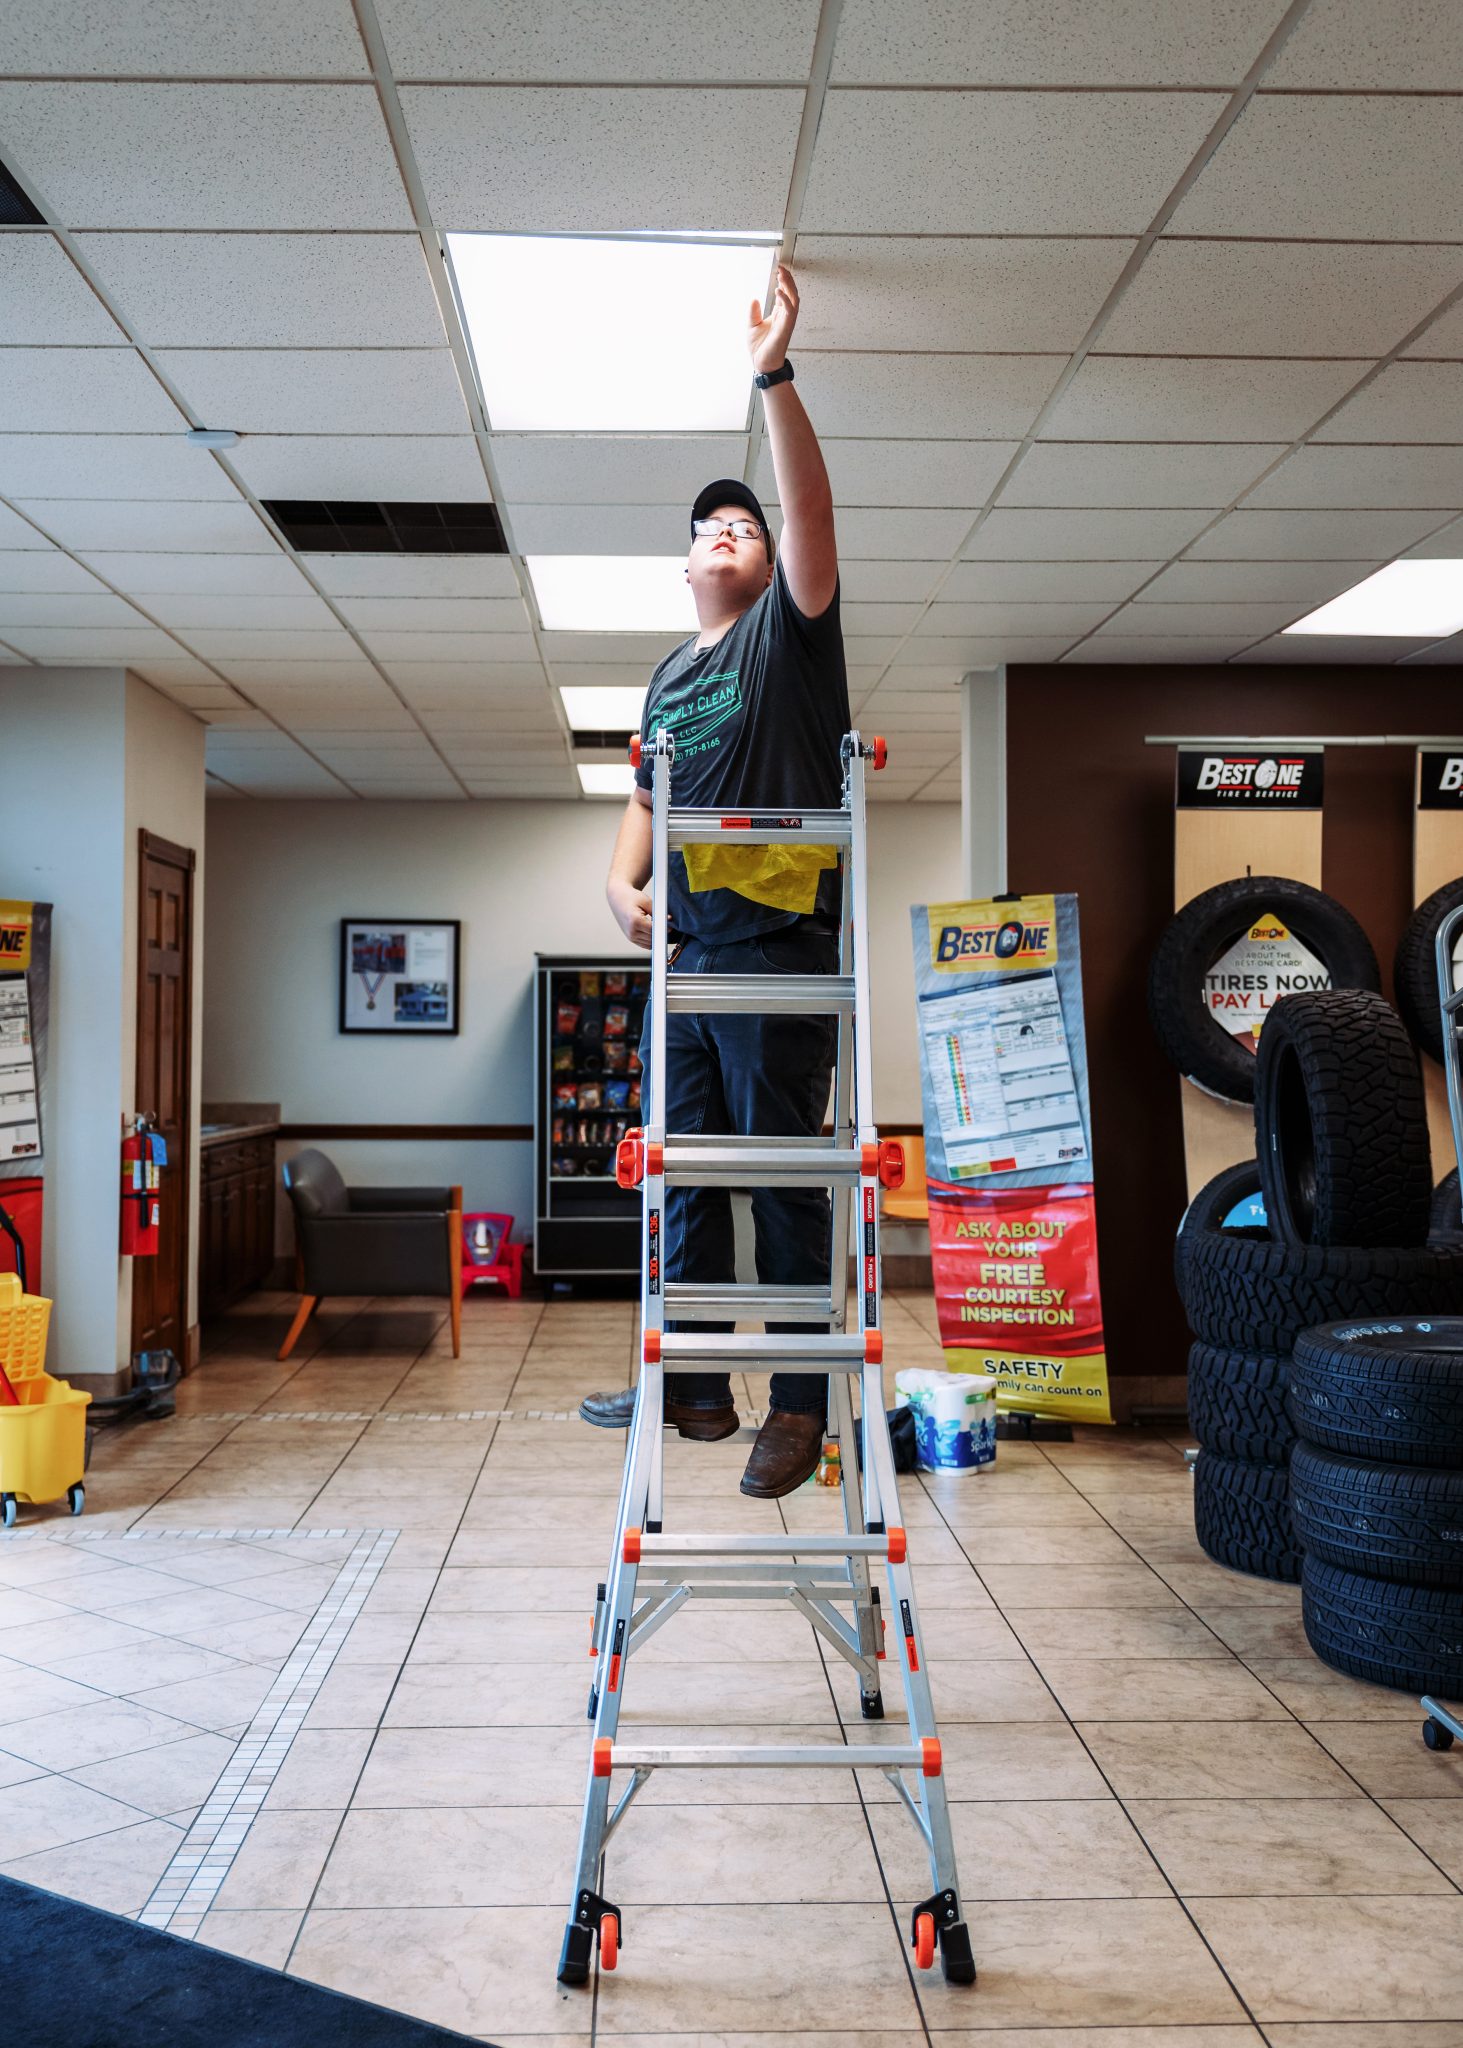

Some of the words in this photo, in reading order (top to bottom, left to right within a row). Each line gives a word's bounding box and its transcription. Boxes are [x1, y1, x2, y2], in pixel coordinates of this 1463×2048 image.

[697, 684, 736, 712] CLEAN
[680, 726, 697, 738] LLC
[685, 737, 720, 757] 727-8165
[1217, 790, 1240, 798] TIRE
[1244, 790, 1251, 798] &
[1255, 790, 1298, 798] SERVICE
[0, 930, 26, 952] NE
[1206, 975, 1268, 991] TIRES
[1276, 975, 1330, 991] NOW
[1211, 992, 1251, 1009] PAY
[955, 1222, 992, 1238] ASK
[997, 1222, 1067, 1239] ABOUT
[984, 1241, 1038, 1258] YOUR
[980, 1263, 1046, 1286] FREE
[965, 1287, 1065, 1306] COURTESY
[960, 1306, 1075, 1326] INSPECTION
[984, 1359, 1063, 1380] SAFETY
[997, 1379, 1021, 1392] mily
[1024, 1383, 1044, 1393] can
[1047, 1385, 1083, 1396] count
[1086, 1388, 1103, 1397] on
